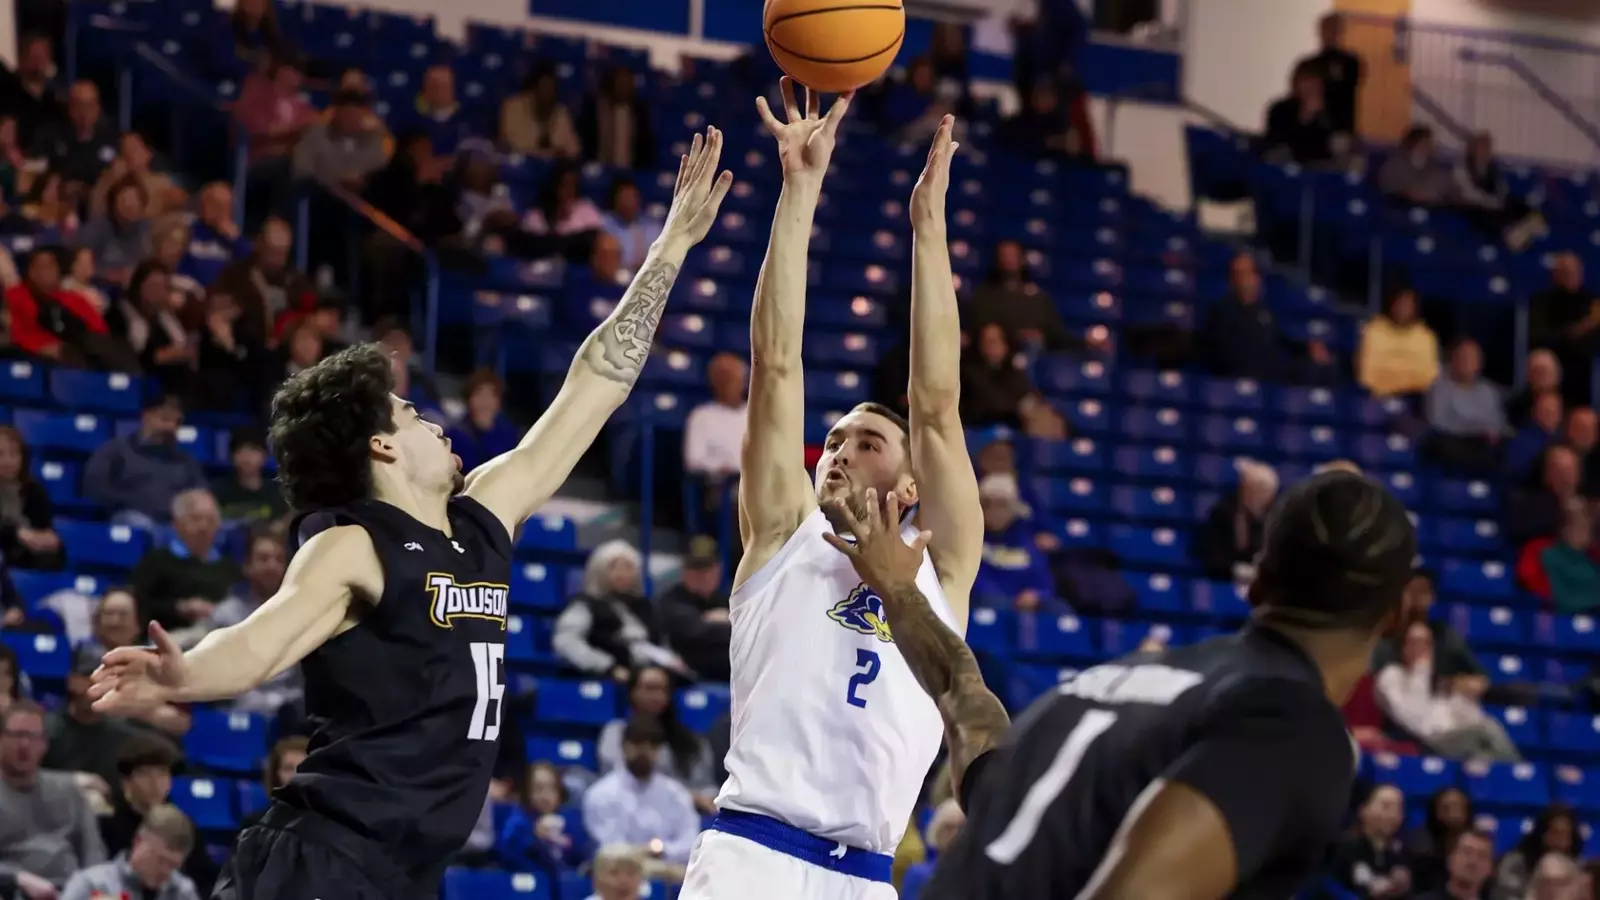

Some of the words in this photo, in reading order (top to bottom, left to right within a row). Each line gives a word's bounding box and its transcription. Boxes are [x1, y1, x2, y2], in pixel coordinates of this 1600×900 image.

[466, 641, 505, 741] 15
[846, 648, 881, 708] 2
[986, 710, 1118, 863] 1
